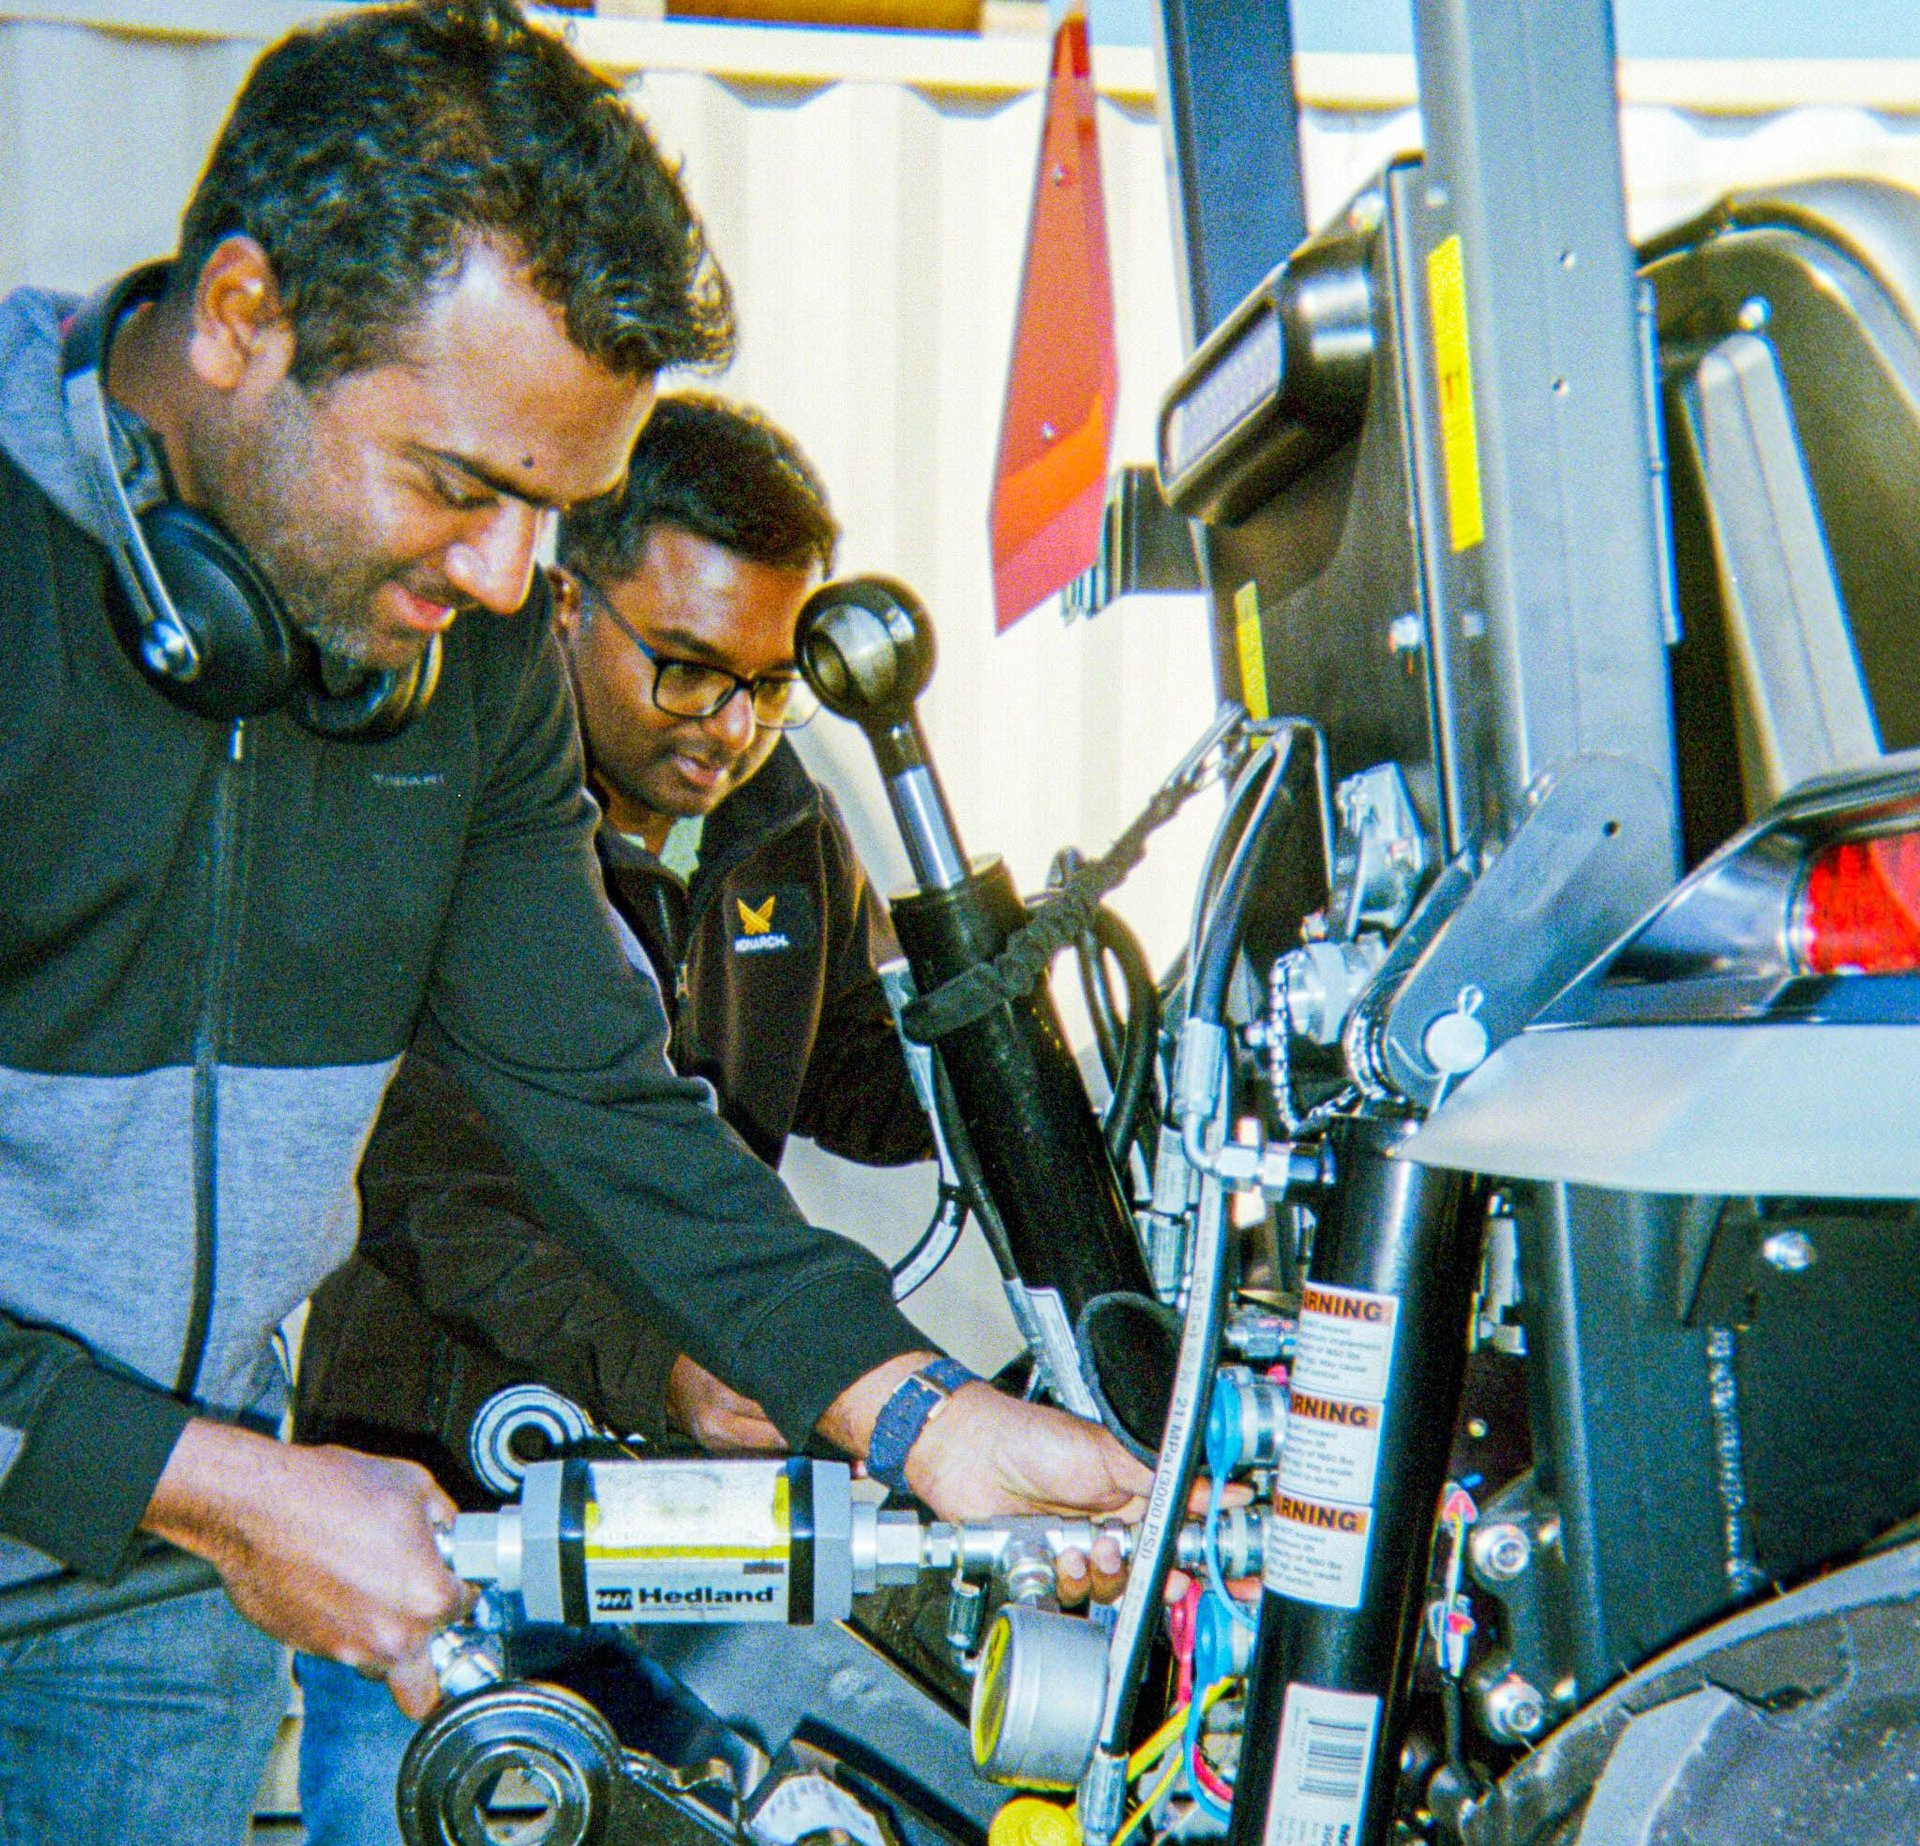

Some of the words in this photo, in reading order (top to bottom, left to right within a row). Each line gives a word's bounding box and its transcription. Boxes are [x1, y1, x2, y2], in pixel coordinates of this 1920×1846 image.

[1304, 1289, 1382, 1321] RNING
[1174, 1397, 1188, 1417] 21
[1291, 1390, 1369, 1426] RNING
[1276, 1494, 1357, 1531] RNING
[638, 1587, 774, 1604] Hedland
